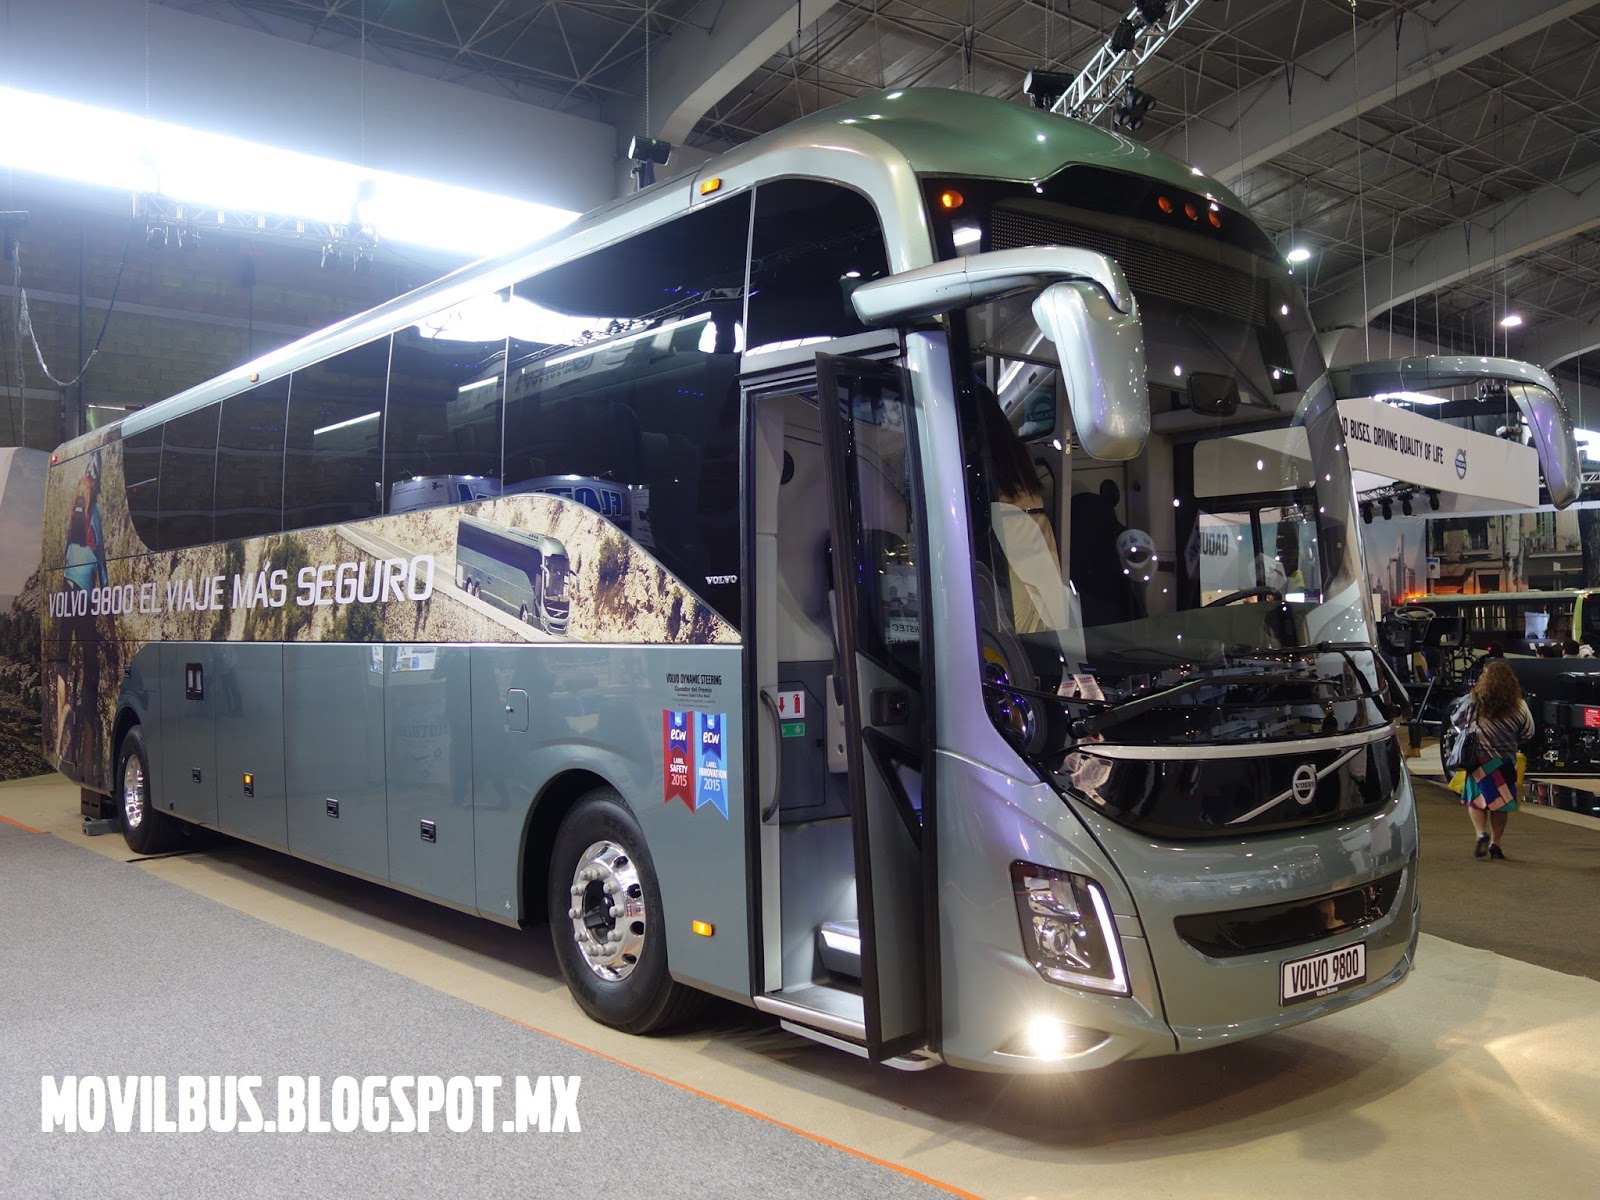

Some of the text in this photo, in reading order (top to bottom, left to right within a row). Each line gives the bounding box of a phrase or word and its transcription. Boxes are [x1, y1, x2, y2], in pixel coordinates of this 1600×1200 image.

[1350, 420, 1372, 443] BUSES.
[1373, 426, 1398, 451] DRIVING
[1399, 435, 1423, 459] QUALITY
[1424, 443, 1432, 461] OF
[1432, 444, 1444, 465] LIFE
[705, 575, 738, 584] VOLVO
[49, 554, 435, 618] VOLVO 9800 EL VIAJE MÁS SEGURO
[666, 673, 722, 685] VOLVO DYNAMIC STEERING
[670, 729, 686, 741] ecw
[703, 732, 720, 744] ecw
[670, 764, 688, 774] SAFETY
[698, 768, 727, 780] INNOVATION
[671, 775, 687, 786] 2015
[704, 779, 720, 791] 2015
[1294, 781, 1315, 789] VOLVO
[1292, 948, 1359, 993] VOLVO 9800
